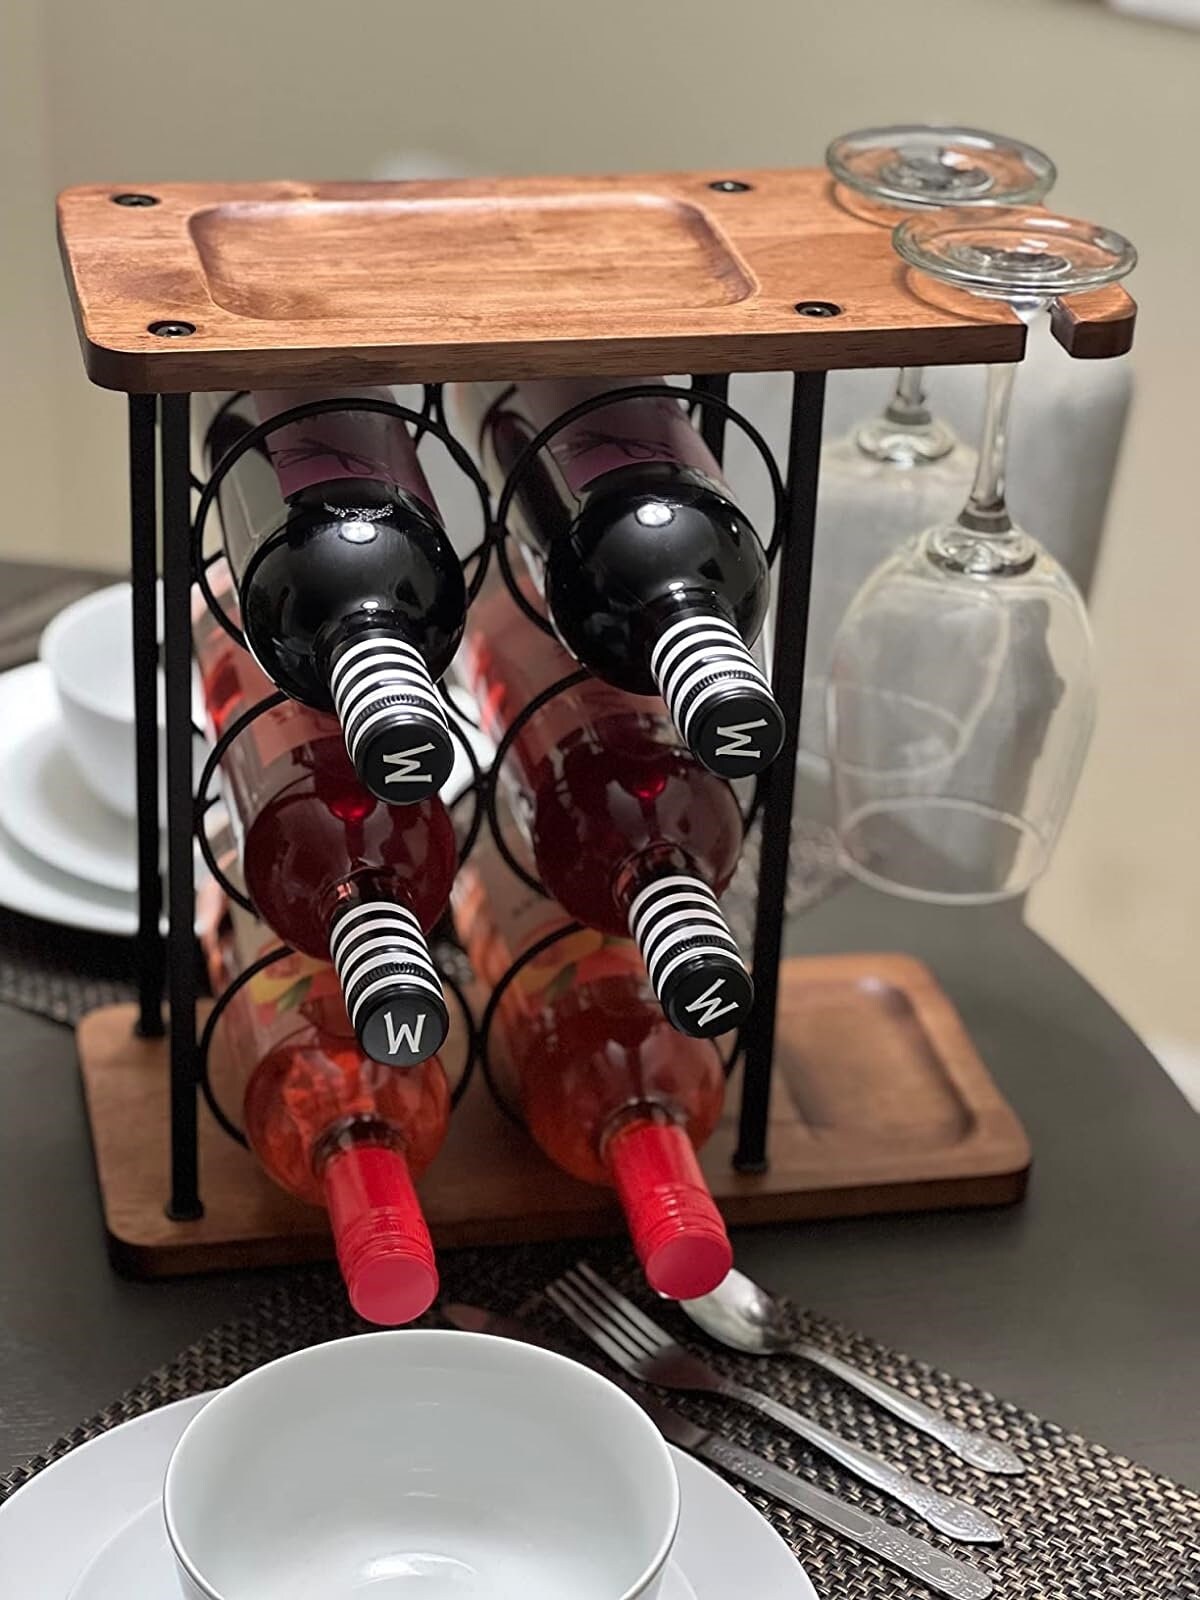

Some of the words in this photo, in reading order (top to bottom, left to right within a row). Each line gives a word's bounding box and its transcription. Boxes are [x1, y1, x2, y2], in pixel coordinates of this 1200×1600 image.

[714, 718, 768, 758] W
[383, 742, 435, 784] W
[685, 978, 739, 1027] W
[383, 1011, 426, 1054] W
